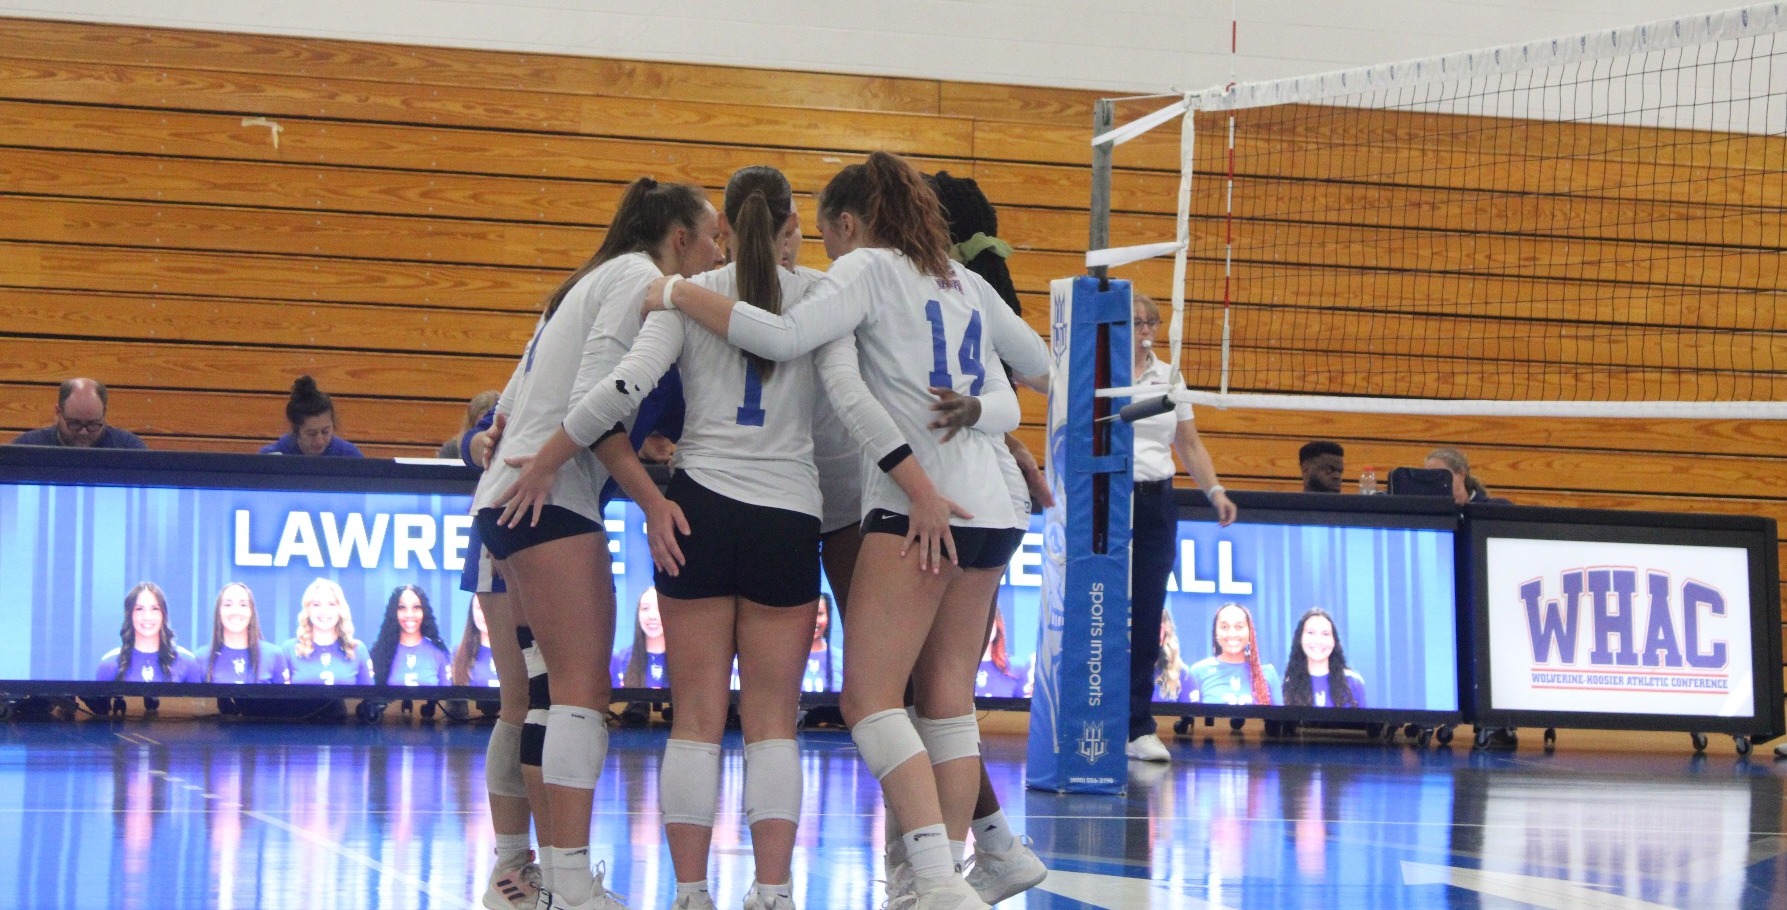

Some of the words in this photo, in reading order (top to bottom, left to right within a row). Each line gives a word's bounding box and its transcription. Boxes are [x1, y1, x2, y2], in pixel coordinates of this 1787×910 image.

[925, 300, 985, 396] 14
[234, 508, 625, 575] LAWREE
[1088, 582, 1104, 636] sports
[1519, 566, 1728, 670] WHAC
[1087, 640, 1103, 706] imports
[1531, 673, 1624, 686] WOLVERINE-HOOSIER
[1626, 676, 1669, 687] ATHLETIC
[1671, 678, 1728, 689] CONFERENCE
